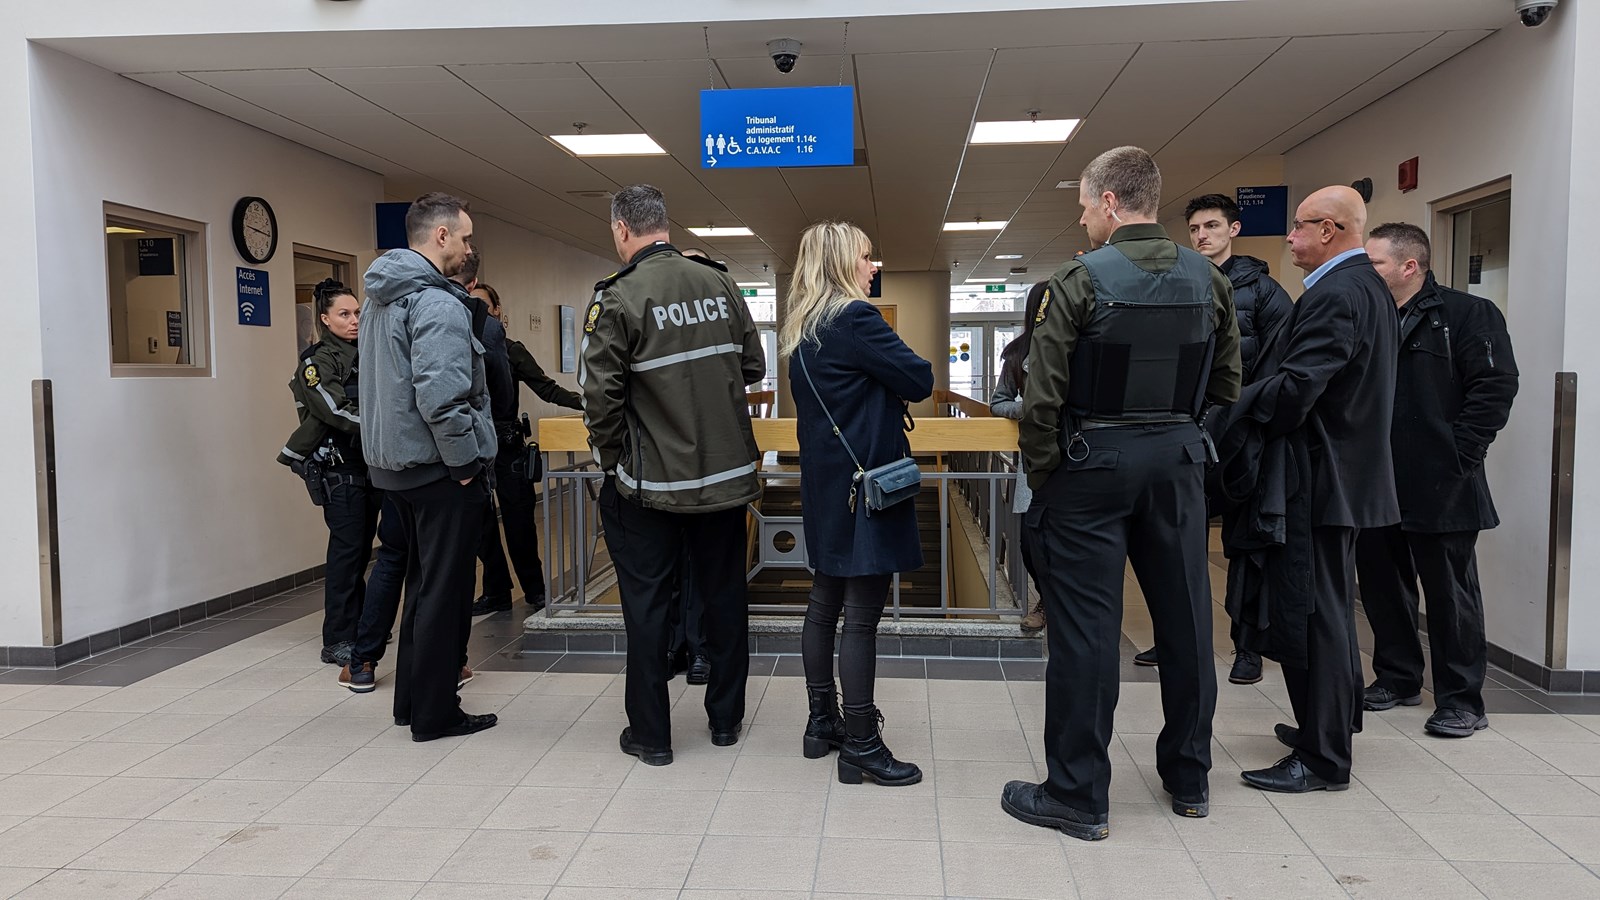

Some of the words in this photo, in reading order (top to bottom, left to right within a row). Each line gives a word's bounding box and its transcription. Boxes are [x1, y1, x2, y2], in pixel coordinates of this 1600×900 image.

[746, 116, 776, 124] Tribunal
[746, 125, 794, 134] administratif
[746, 136, 756, 144] du
[758, 135, 794, 145] logement
[796, 135, 817, 143] 1.14c
[746, 146, 781, 154] C.A.V.A.C
[796, 145, 813, 153] 1.16
[239, 270, 256, 281] Accès
[240, 284, 263, 296] Internet
[652, 297, 729, 330] POLICE
